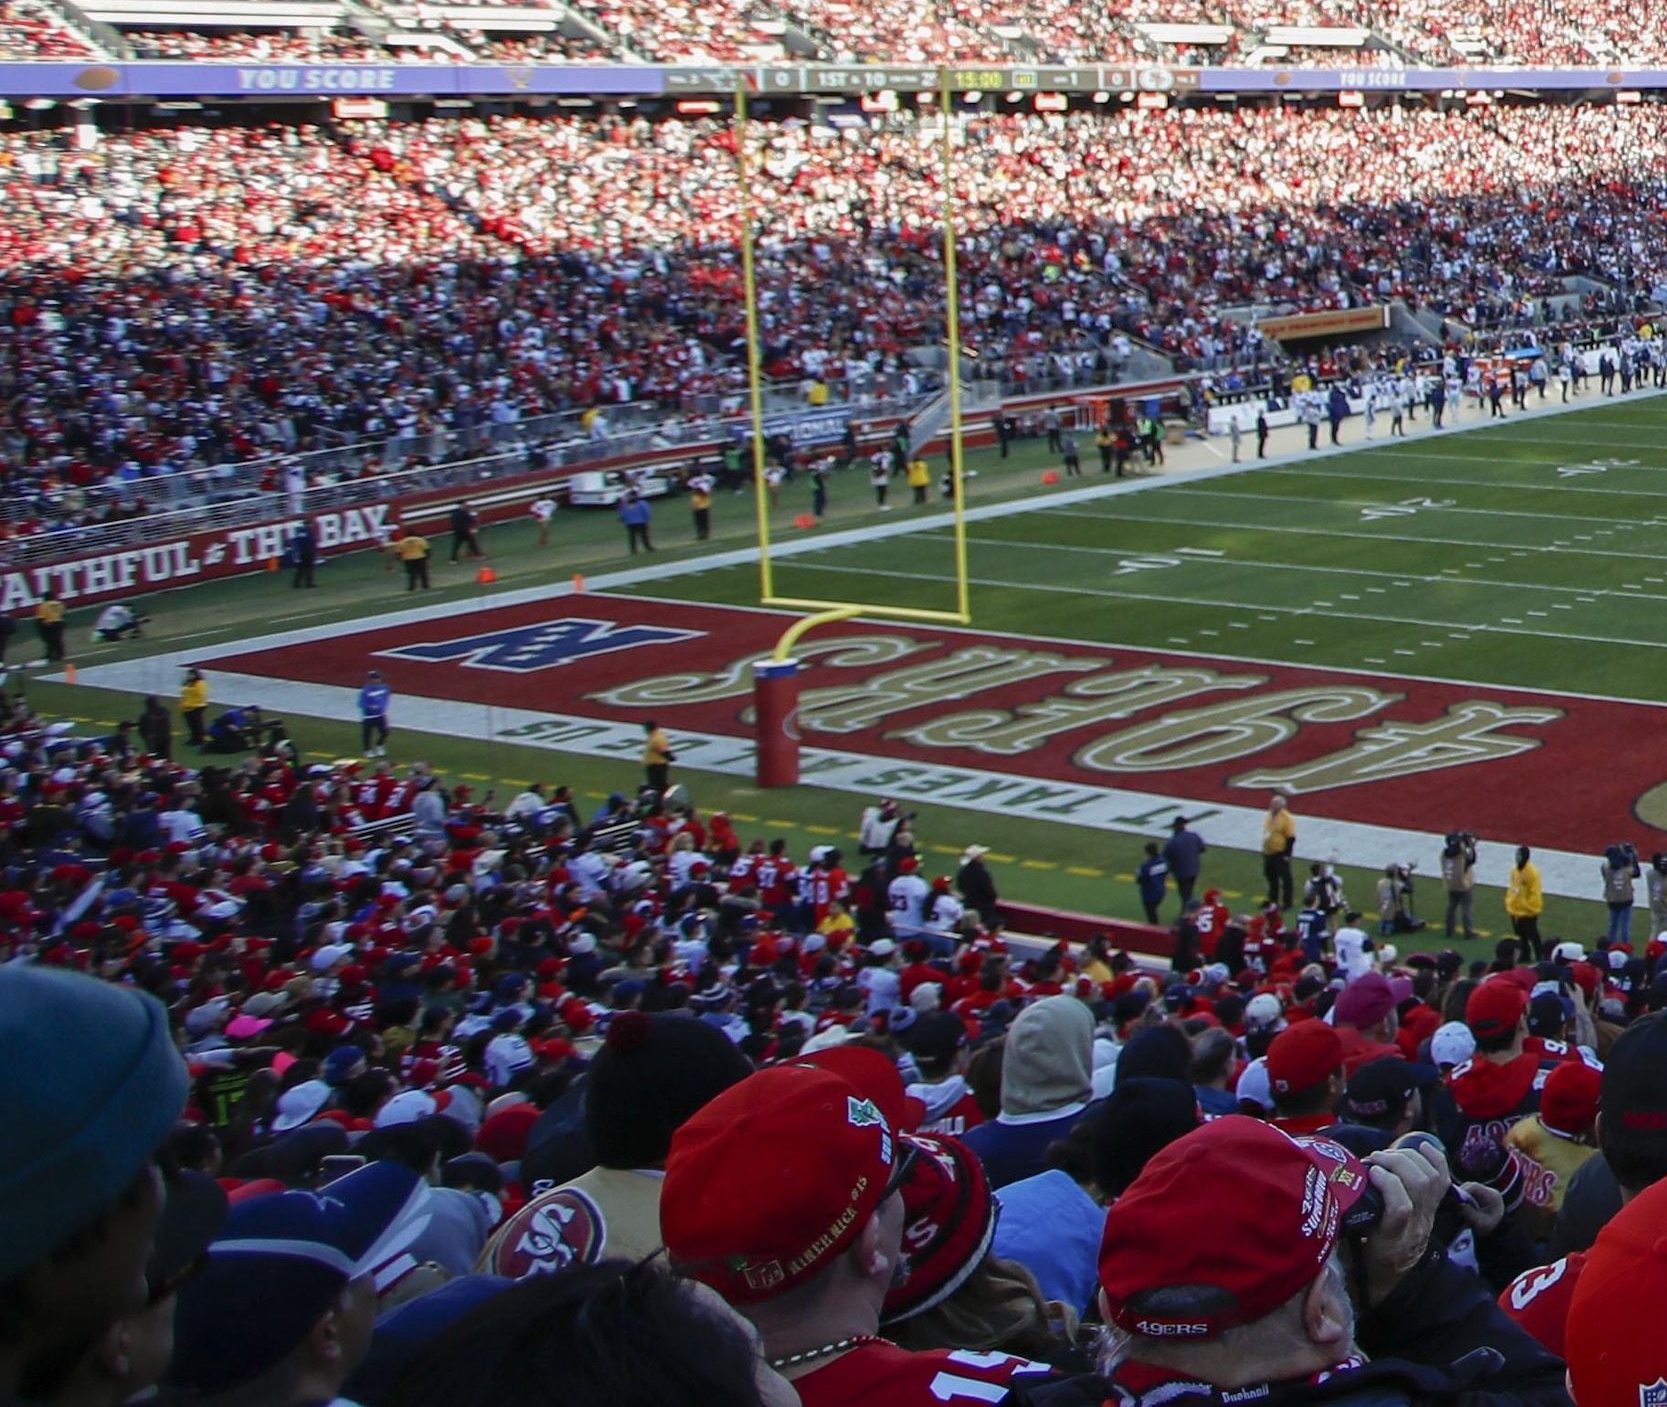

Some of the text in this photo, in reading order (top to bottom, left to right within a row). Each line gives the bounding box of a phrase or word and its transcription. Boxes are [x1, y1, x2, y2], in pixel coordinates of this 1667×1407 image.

[238, 69, 395, 89] YOU SCORE
[1340, 72, 1406, 87] YOU SCORE
[0, 541, 200, 612] AITHFUL
[316, 504, 390, 548] BAY
[1135, 1320, 1208, 1336] 49ERS
